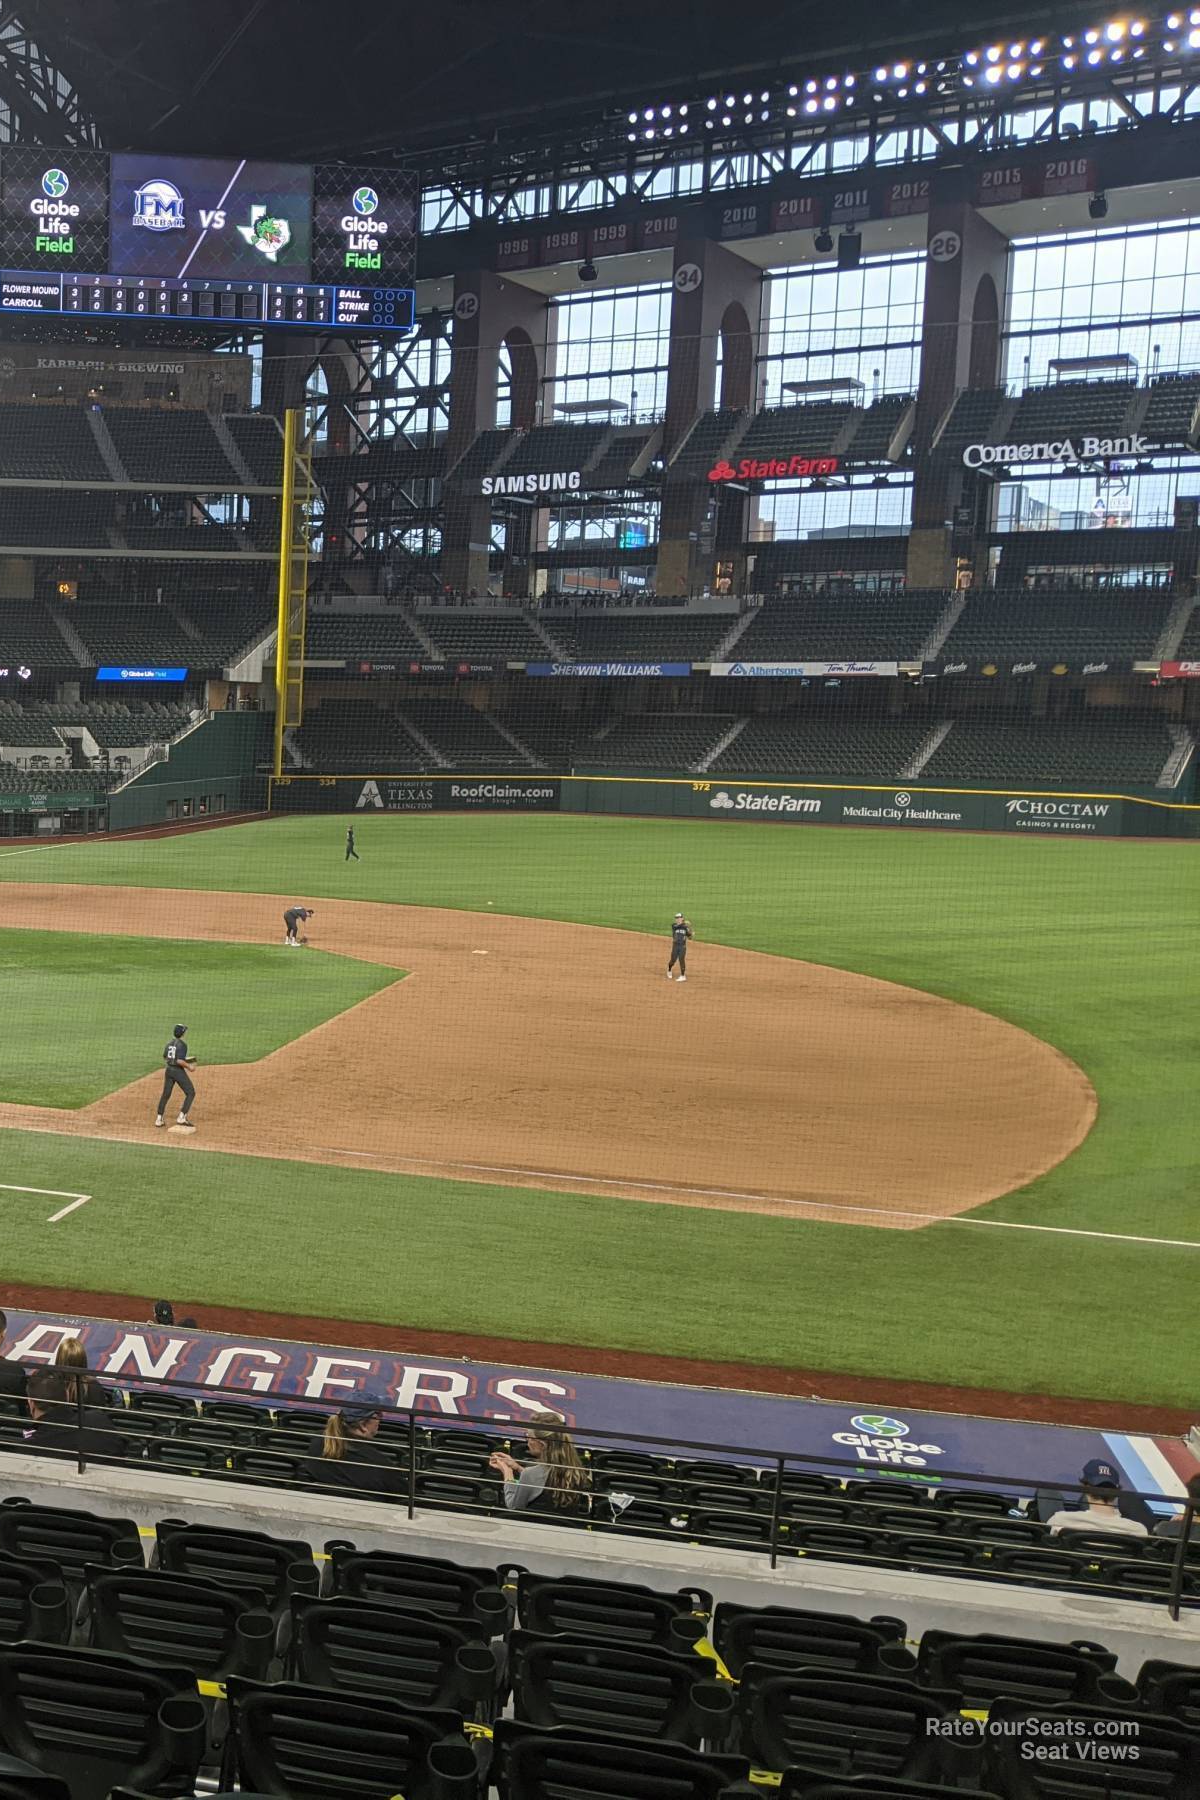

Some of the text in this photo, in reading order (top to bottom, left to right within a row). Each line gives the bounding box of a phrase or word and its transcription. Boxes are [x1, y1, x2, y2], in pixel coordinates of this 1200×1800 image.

[982, 168, 1021, 186] 2015
[1045, 159, 1088, 179] 2016
[892, 181, 929, 200] 2012
[30, 198, 80, 217] Globe
[134, 191, 184, 220] FM
[778, 198, 812, 216] 2011
[834, 189, 868, 210] 2011
[133, 217, 186, 229] BASEBALL
[199, 210, 227, 229] VS
[722, 205, 758, 224] 2010
[40, 217, 70, 234] Life
[341, 216, 388, 234] Globe
[593, 224, 627, 242] 1999
[644, 217, 678, 235] 2010
[36, 236, 74, 253] Field
[349, 234, 378, 250] Life
[546, 231, 579, 249] 1998
[932, 239, 958, 257] 26
[345, 253, 381, 269] Field
[73, 276, 78, 284] 1
[117, 278, 122, 286] 3
[319, 288, 324, 296] E
[678, 269, 699, 286] 34
[2, 285, 32, 294] FLOWER
[32, 286, 60, 295] MOUND
[72, 288, 78, 297] 3
[94, 289, 100, 298] 2
[117, 291, 122, 299] 0
[138, 292, 144, 300] 0
[182, 294, 188, 302] 3
[339, 290, 361, 298] BALL
[2, 298, 43, 308] CARROLL
[73, 301, 78, 309] 1
[116, 303, 122, 311] 3
[138, 304, 144, 312] 0
[161, 305, 166, 313] 1
[297, 311, 302, 319] 6
[319, 312, 324, 320] 1
[338, 302, 370, 311] STRIKE
[457, 298, 476, 314] 42
[338, 314, 358, 322] OUT
[118, 362, 184, 374] BREWING
[1082, 433, 1148, 458] Bank
[481, 471, 581, 496] SAMSUNG
[748, 664, 804, 676] Albertsons
[825, 662, 876, 674] Tom Thumb
[388, 789, 433, 800] TEXAS
[451, 784, 554, 798] RoofClaim.com
[692, 783, 712, 792] 372
[843, 806, 961, 821] Medical City Healthcare
[1016, 800, 1110, 817] CHOCTAW
[1016, 820, 1051, 828] CASINOS
[1060, 822, 1096, 830] RESORTS
[832, 1432, 944, 1455] Globe
[856, 1447, 927, 1466] Life
